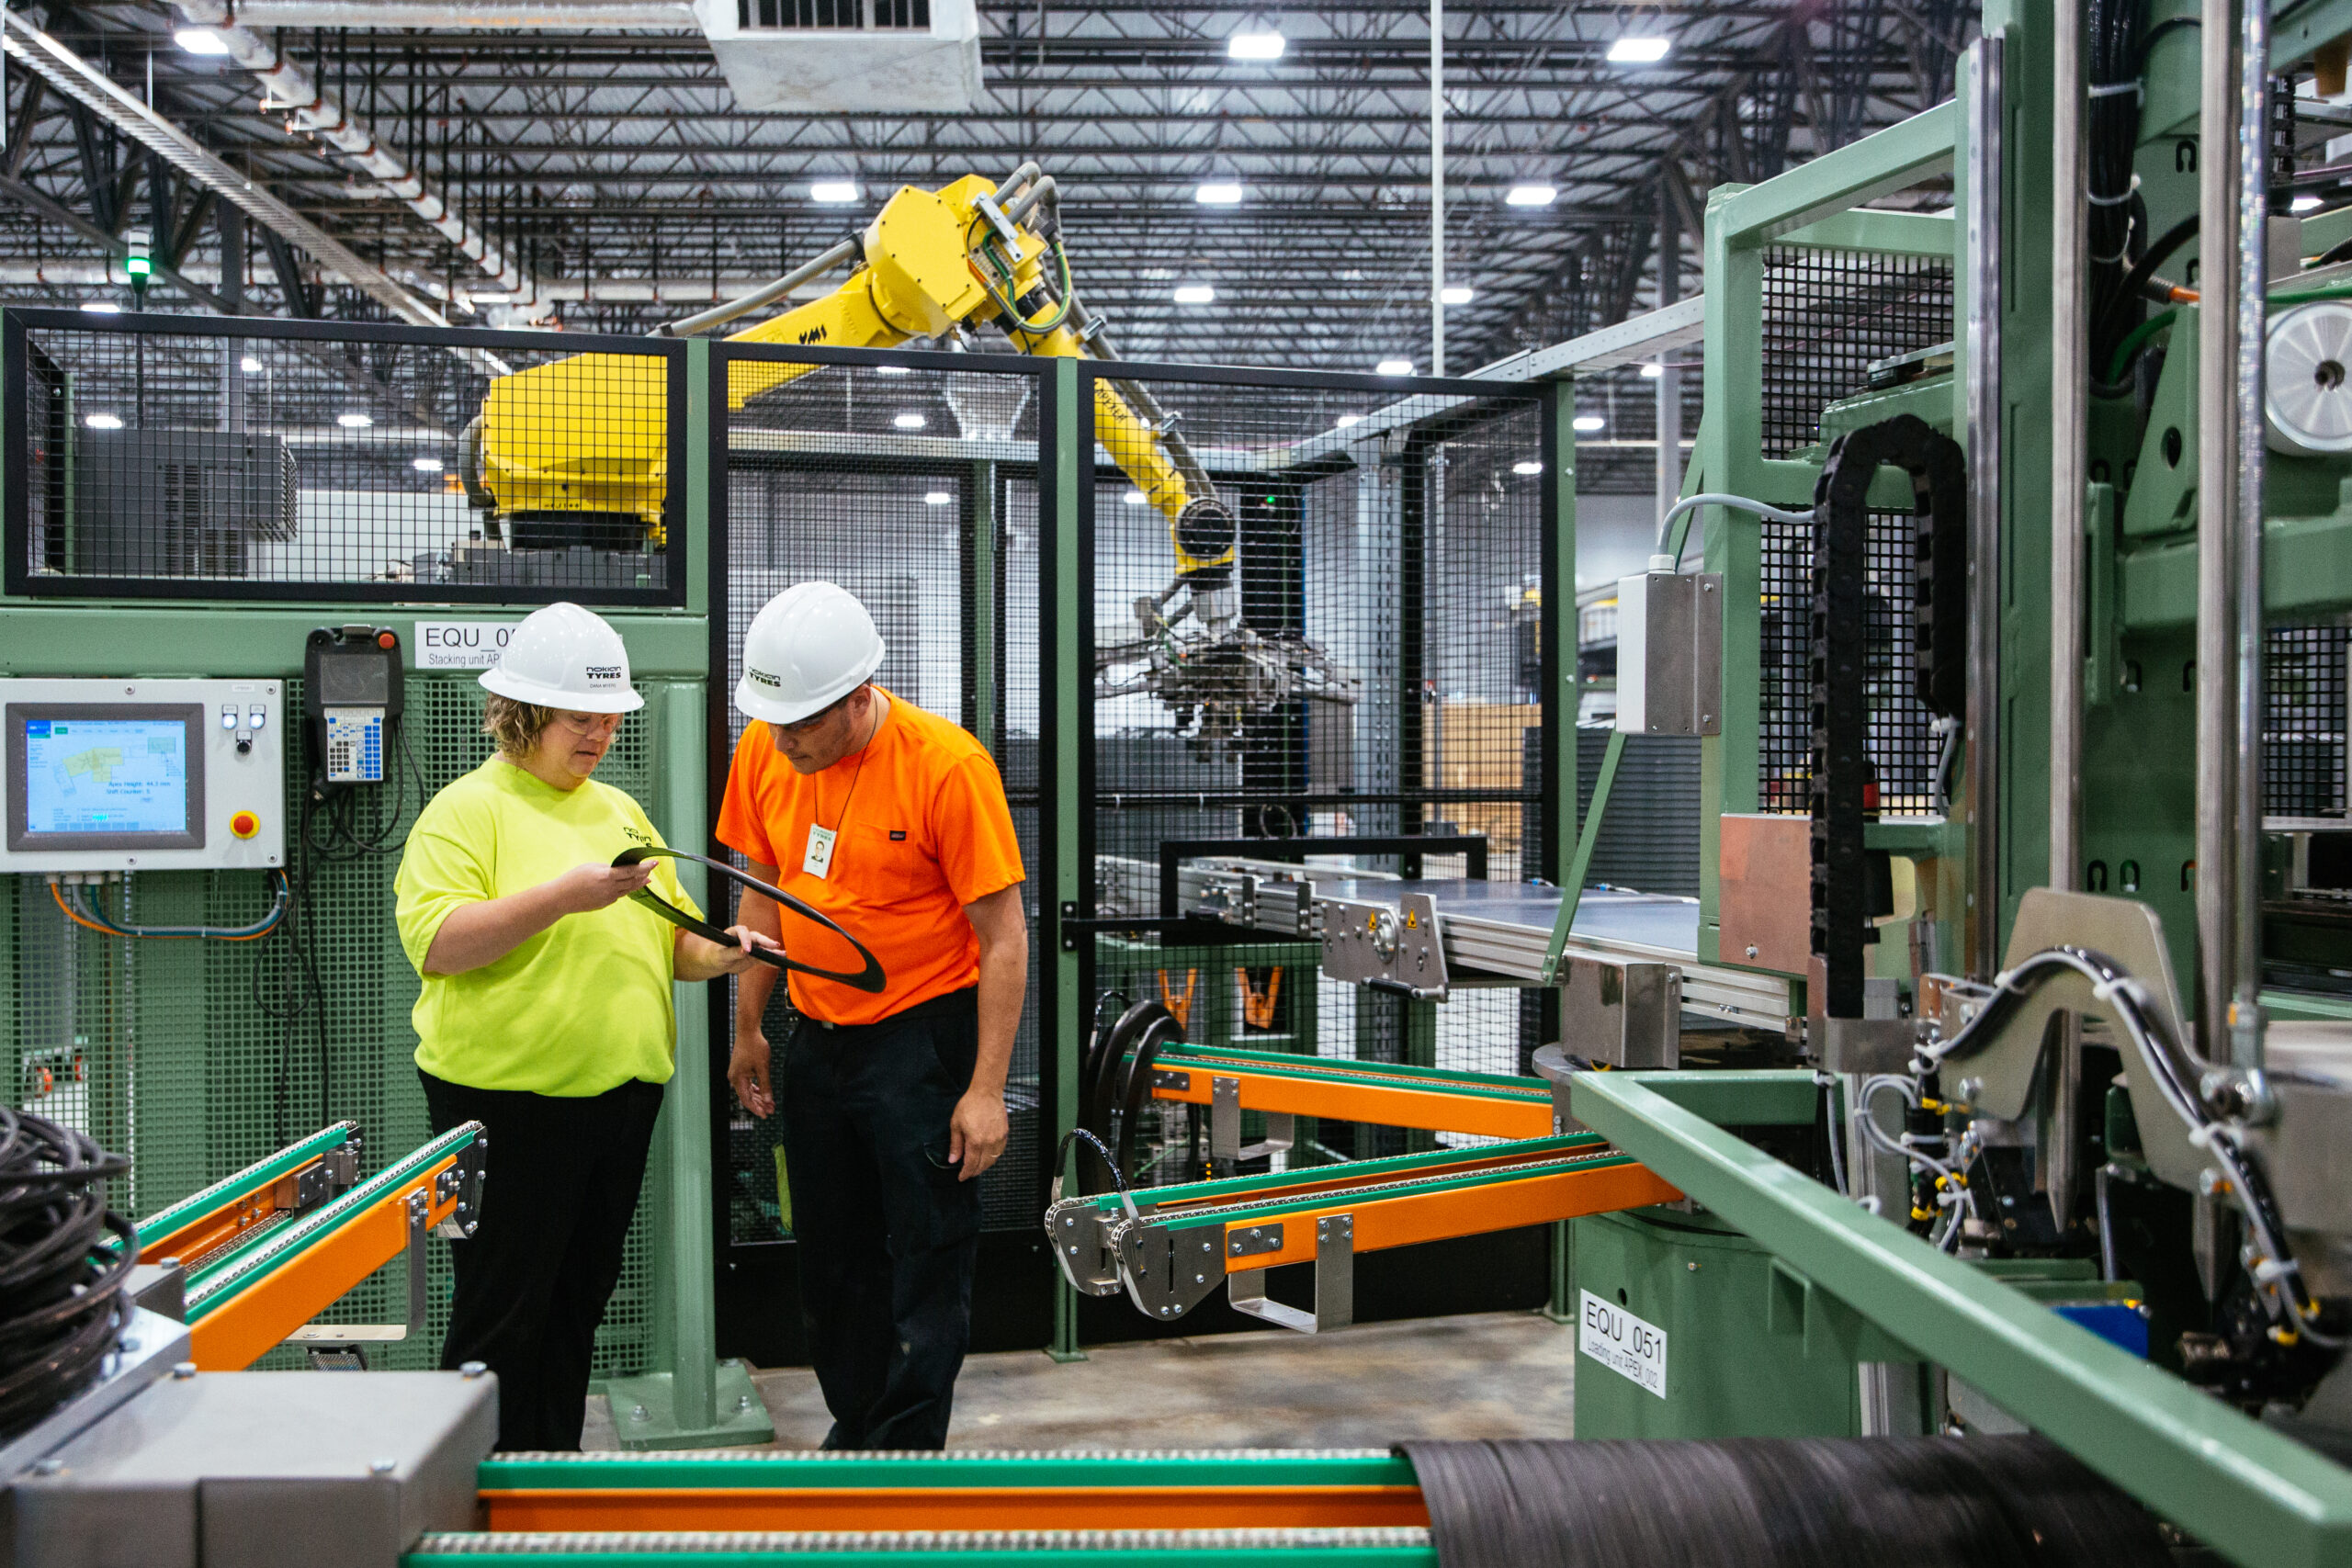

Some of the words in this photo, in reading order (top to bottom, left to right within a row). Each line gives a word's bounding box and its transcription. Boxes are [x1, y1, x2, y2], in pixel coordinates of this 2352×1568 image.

[425, 627, 516, 652] EQU_0
[428, 653, 466, 668] Stacking
[469, 653, 484, 665] unit
[486, 653, 502, 666] AP
[749, 671, 781, 687] TYRES
[1587, 1300, 1661, 1364] EQU_051
[1588, 1335, 1611, 1366] Loading
[1612, 1351, 1624, 1370] unit
